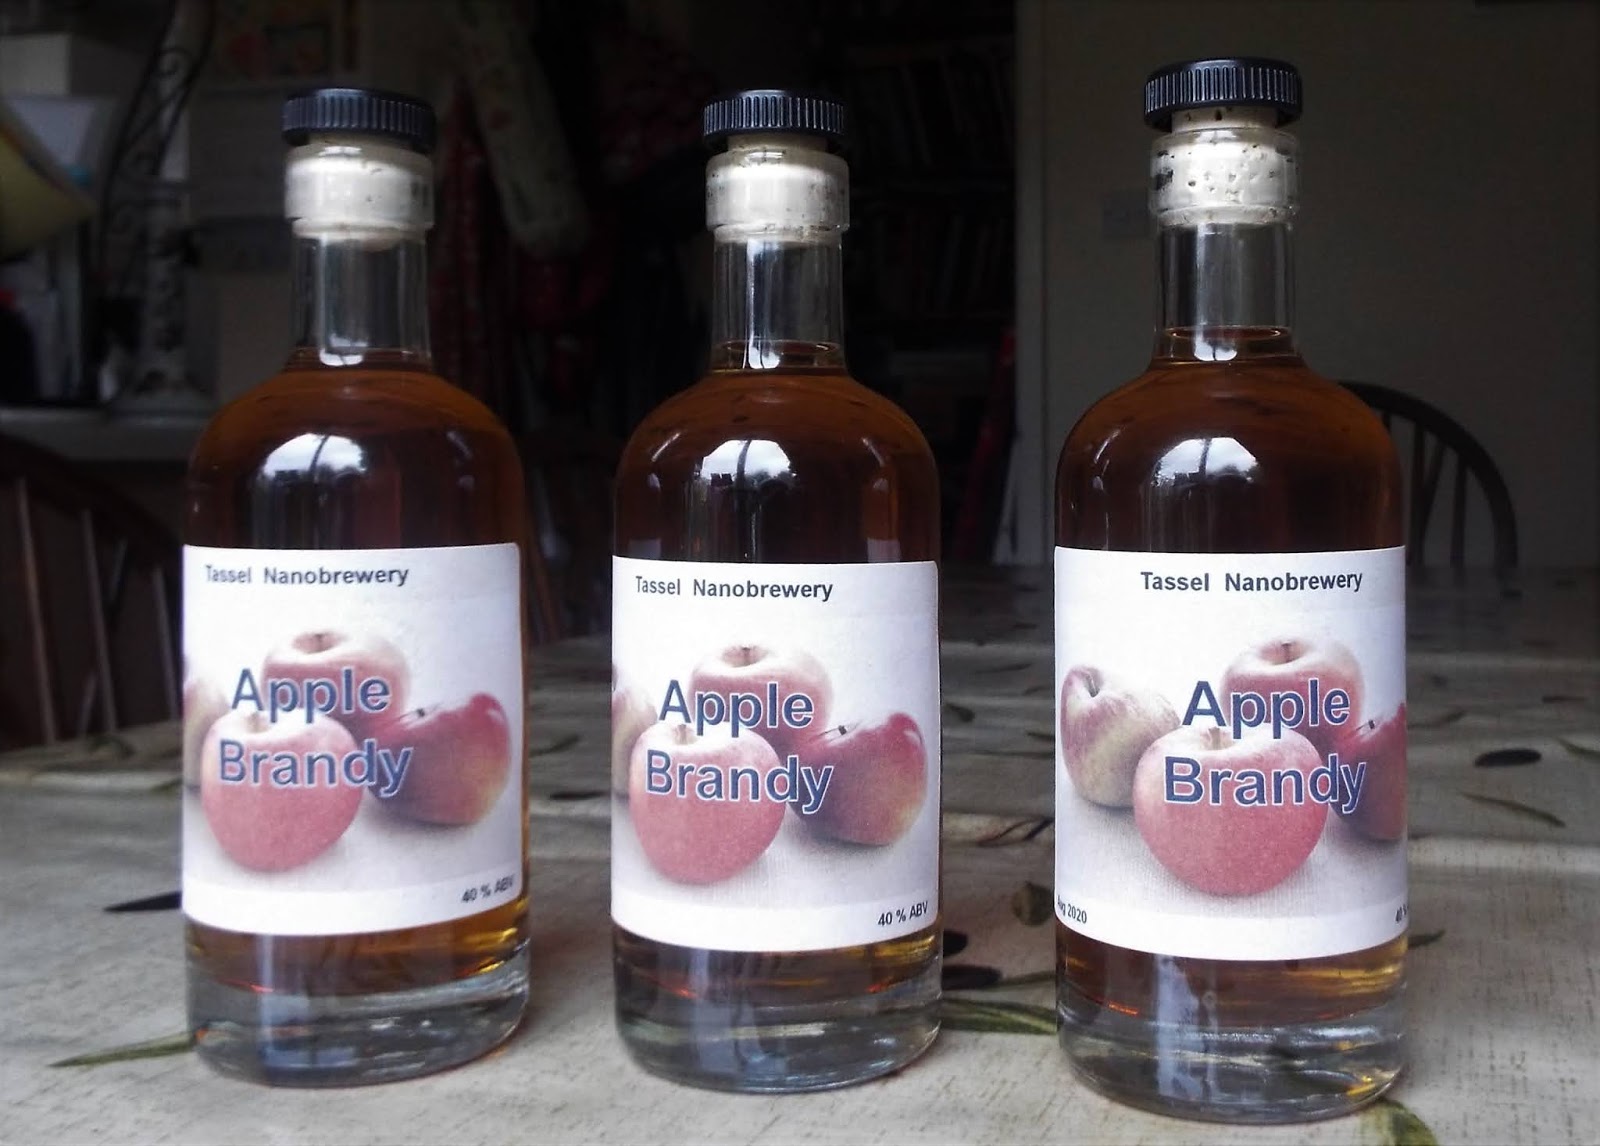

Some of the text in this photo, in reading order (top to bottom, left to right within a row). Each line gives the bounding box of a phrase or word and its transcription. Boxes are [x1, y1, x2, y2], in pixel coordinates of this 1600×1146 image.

[206, 564, 409, 587] Tassel Nanobrewery
[635, 576, 833, 602] Tassel Nanobrewery
[1141, 572, 1363, 592] Tassel Nanobrewery
[231, 668, 391, 724] Apple
[659, 679, 814, 738] Apple
[1181, 678, 1351, 740] Apple
[219, 738, 413, 799] Brandy
[645, 749, 834, 815] Brandy
[1163, 753, 1367, 814] Brandy
[461, 887, 478, 903] 40
[877, 900, 928, 926] 40 % ABV
[1067, 903, 1088, 925] 2020
